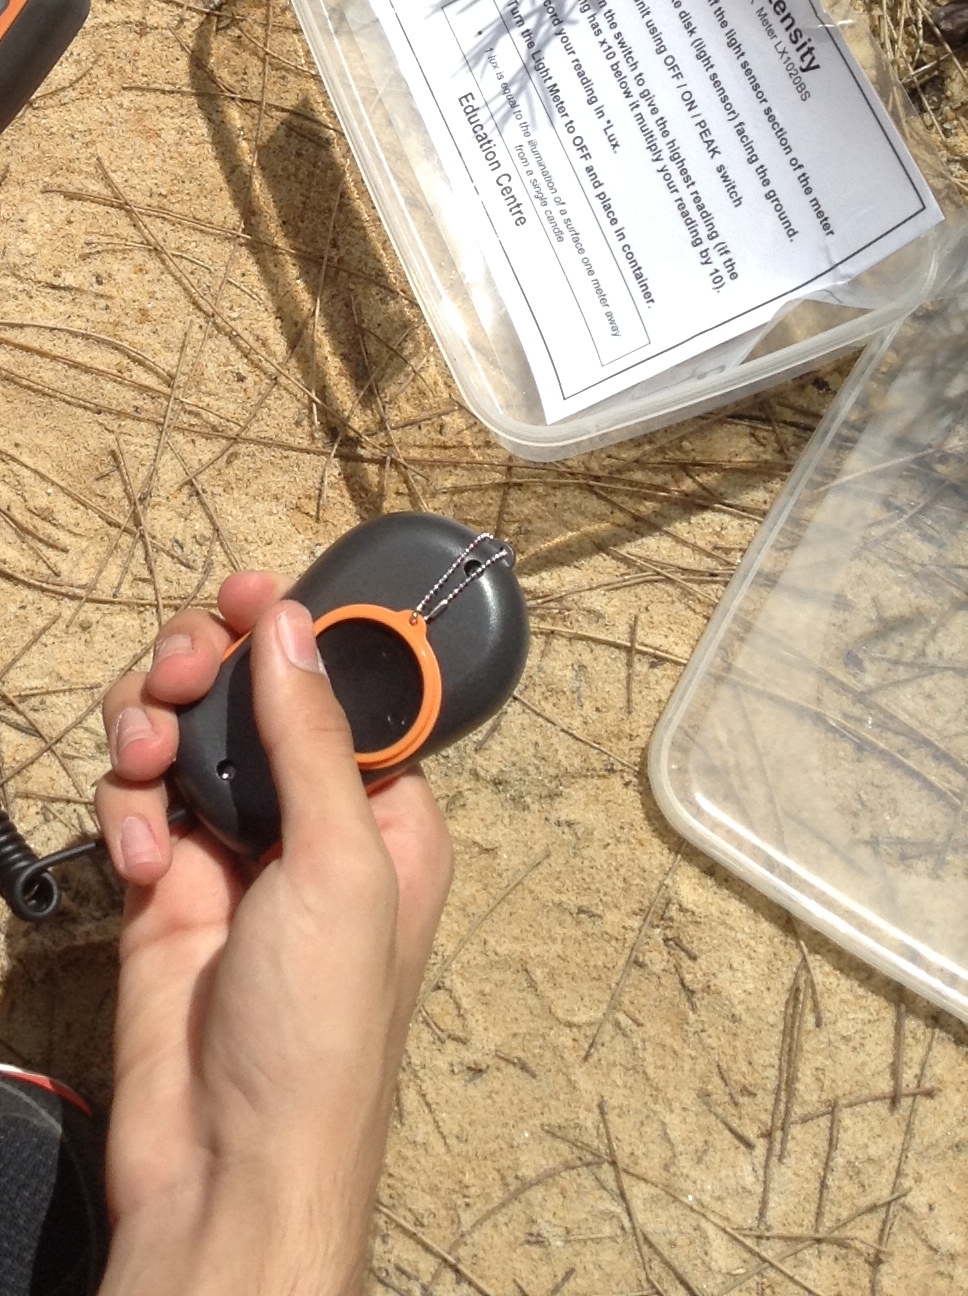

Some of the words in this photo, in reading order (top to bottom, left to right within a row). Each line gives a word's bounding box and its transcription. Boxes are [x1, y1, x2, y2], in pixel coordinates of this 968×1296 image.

[586, 12, 604, 37] has
[602, 8, 619, 30] the
[677, 9, 698, 38] disk
[519, 27, 537, 50] the
[597, 37, 617, 61] x10
[643, 17, 669, 55] using
[487, 53, 501, 70] lux
[612, 30, 640, 72] switch
[689, 36, 716, 73] (light
[754, 6, 779, 41] Meter
[772, 39, 812, 102] LX1020BS
[495, 70, 505, 81] is
[529, 48, 554, 84] Light
[553, 27, 577, 57] your
[569, 57, 600, 106] reading
[592, 104, 606, 120] in
[608, 60, 635, 100] below
[632, 71, 647, 87] to
[662, 53, 684, 81] OFF
[499, 81, 520, 111] equal
[545, 82, 571, 119] Meter
[675, 82, 688, 90] /
[679, 89, 698, 112] ON
[707, 71, 741, 122] sensor)
[511, 108, 524, 121] to
[627, 99, 641, 112] it
[638, 87, 661, 116] give
[689, 111, 702, 119] /
[518, 120, 532, 138] the
[563, 118, 577, 135] to
[654, 115, 672, 138] the
[712, 5, 730, 29] the
[723, 28, 746, 61] light
[739, 59, 769, 105] sensor
[762, 105, 794, 156] section
[788, 155, 804, 172] of
[796, 171, 814, 196] the
[808, 196, 836, 237] meter
[570, 134, 593, 162] OFF
[631, 111, 665, 163] multiply
[693, 118, 722, 159] PEAK
[731, 120, 761, 165] facing
[456, 91, 504, 172] Education
[493, 171, 529, 227] Centre
[513, 143, 531, 168] from
[525, 138, 560, 195] illumination
[663, 137, 697, 190] highest
[524, 168, 534, 177] a
[583, 164, 604, 190] and
[655, 163, 680, 195] your
[714, 162, 744, 208] switch
[753, 163, 772, 188] the
[528, 177, 549, 208] single
[552, 195, 566, 207] of
[558, 208, 568, 216] a
[594, 190, 620, 227] place
[672, 196, 705, 248] reading
[687, 188, 721, 241] reading
[762, 187, 801, 244] ground.
[562, 216, 587, 255] surface
[613, 226, 627, 242] in
[697, 246, 714, 267] by
[711, 240, 731, 258] (if
[580, 255, 596, 277] one
[617, 242, 659, 308] container.
[704, 266, 729, 295] 10).
[721, 256, 740, 281] the
[589, 277, 611, 309] meter
[602, 309, 622, 338] away
